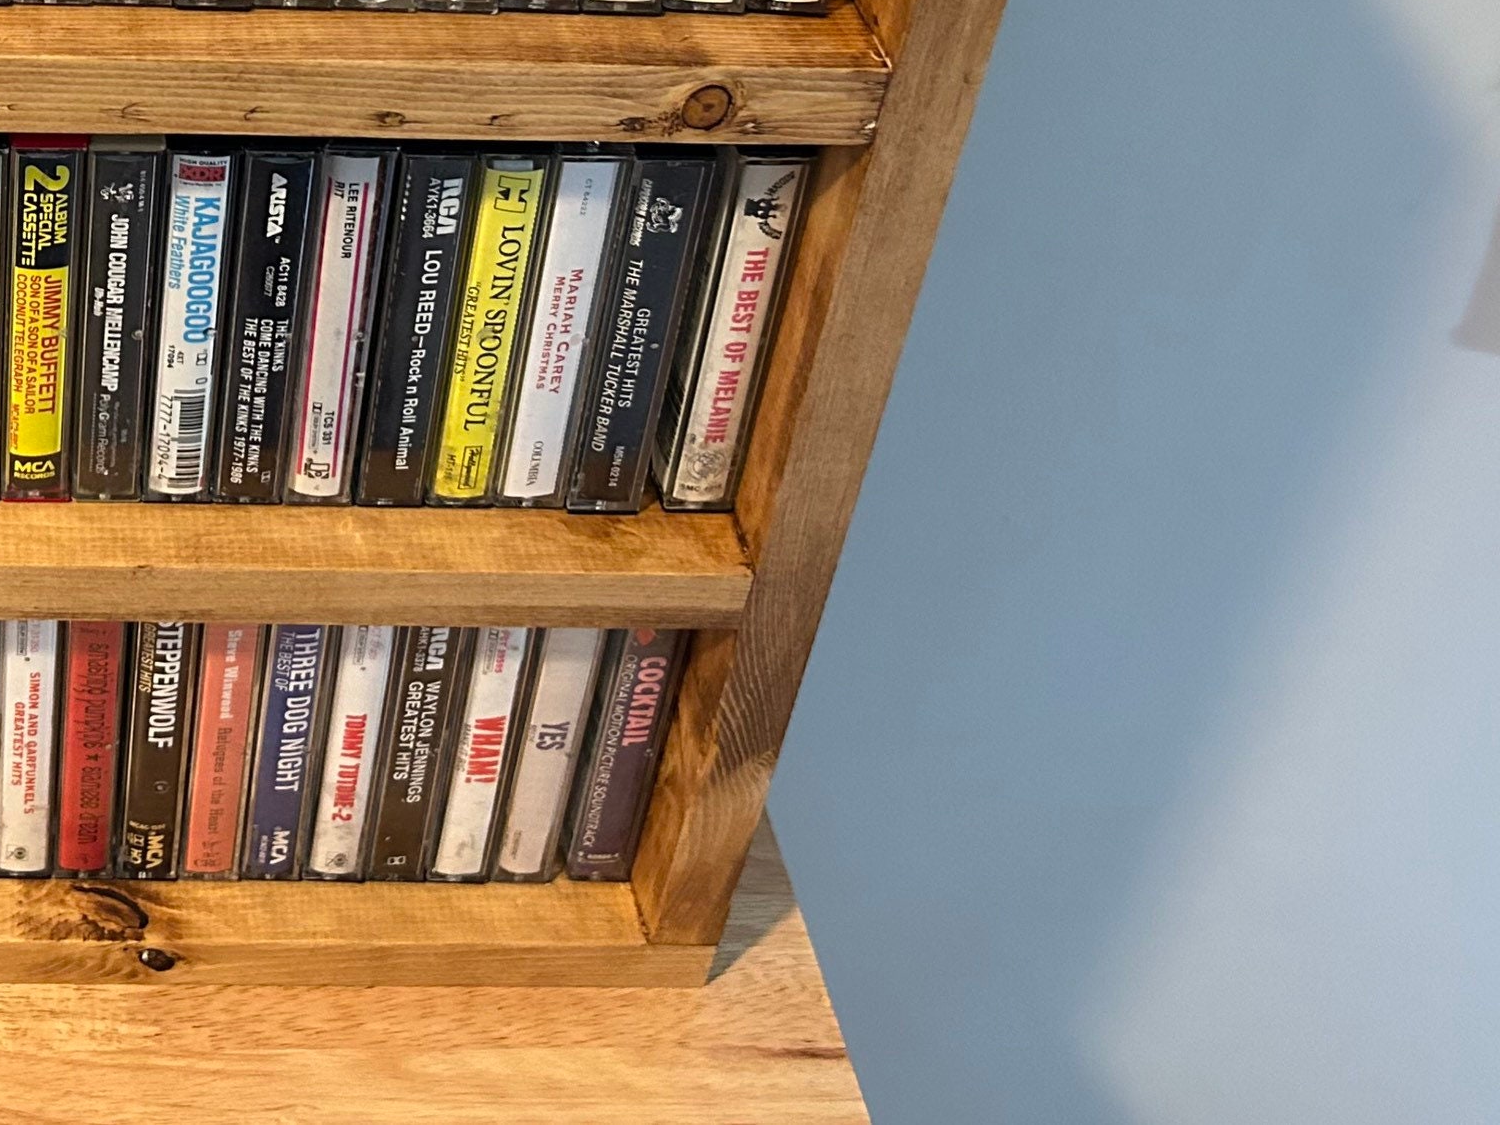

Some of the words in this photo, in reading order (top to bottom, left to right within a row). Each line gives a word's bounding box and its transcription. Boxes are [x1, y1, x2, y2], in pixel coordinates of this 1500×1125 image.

[23, 164, 70, 191] 2
[53, 193, 68, 244] ALBUM
[108, 213, 129, 249] JOHN
[172, 194, 190, 233] White
[265, 172, 287, 238] ARISTA
[105, 252, 127, 304] COUGAR
[168, 236, 186, 289] Feathers
[182, 196, 220, 344] KAJAGOOGOO
[488, 224, 525, 306] LOVIN'
[623, 258, 643, 284] THE
[740, 247, 769, 282] THE
[41, 274, 62, 330] JIMMY
[558, 267, 584, 334] MARIAH
[608, 287, 637, 359] MARSHALL
[727, 290, 760, 334] BEST
[37, 334, 59, 414] BUFFETT
[100, 306, 122, 391] MELLENCAMP
[462, 308, 508, 431] SPOONFUL
[547, 340, 569, 394] CAREY
[721, 341, 747, 363] OF
[597, 363, 621, 413] TUCKER
[701, 369, 741, 444] MELANIE
[588, 415, 610, 451] BAND
[287, 627, 320, 691] THREE
[28, 671, 40, 709] SIMON
[281, 695, 311, 733] DOG
[398, 681, 423, 748] GREATEST
[416, 680, 441, 738] WAYLON
[620, 656, 667, 746] COCKTAIL
[26, 713, 37, 736] AND
[340, 713, 367, 759] TOMMY
[464, 714, 509, 784] WHAM!
[534, 721, 570, 751] YES
[22, 740, 37, 814] GARFUNKEL'S
[273, 738, 304, 792] NIGHT
[330, 762, 359, 821] TUTONE-2
[391, 751, 410, 780] HITS
[405, 740, 430, 803] JENNINGS
